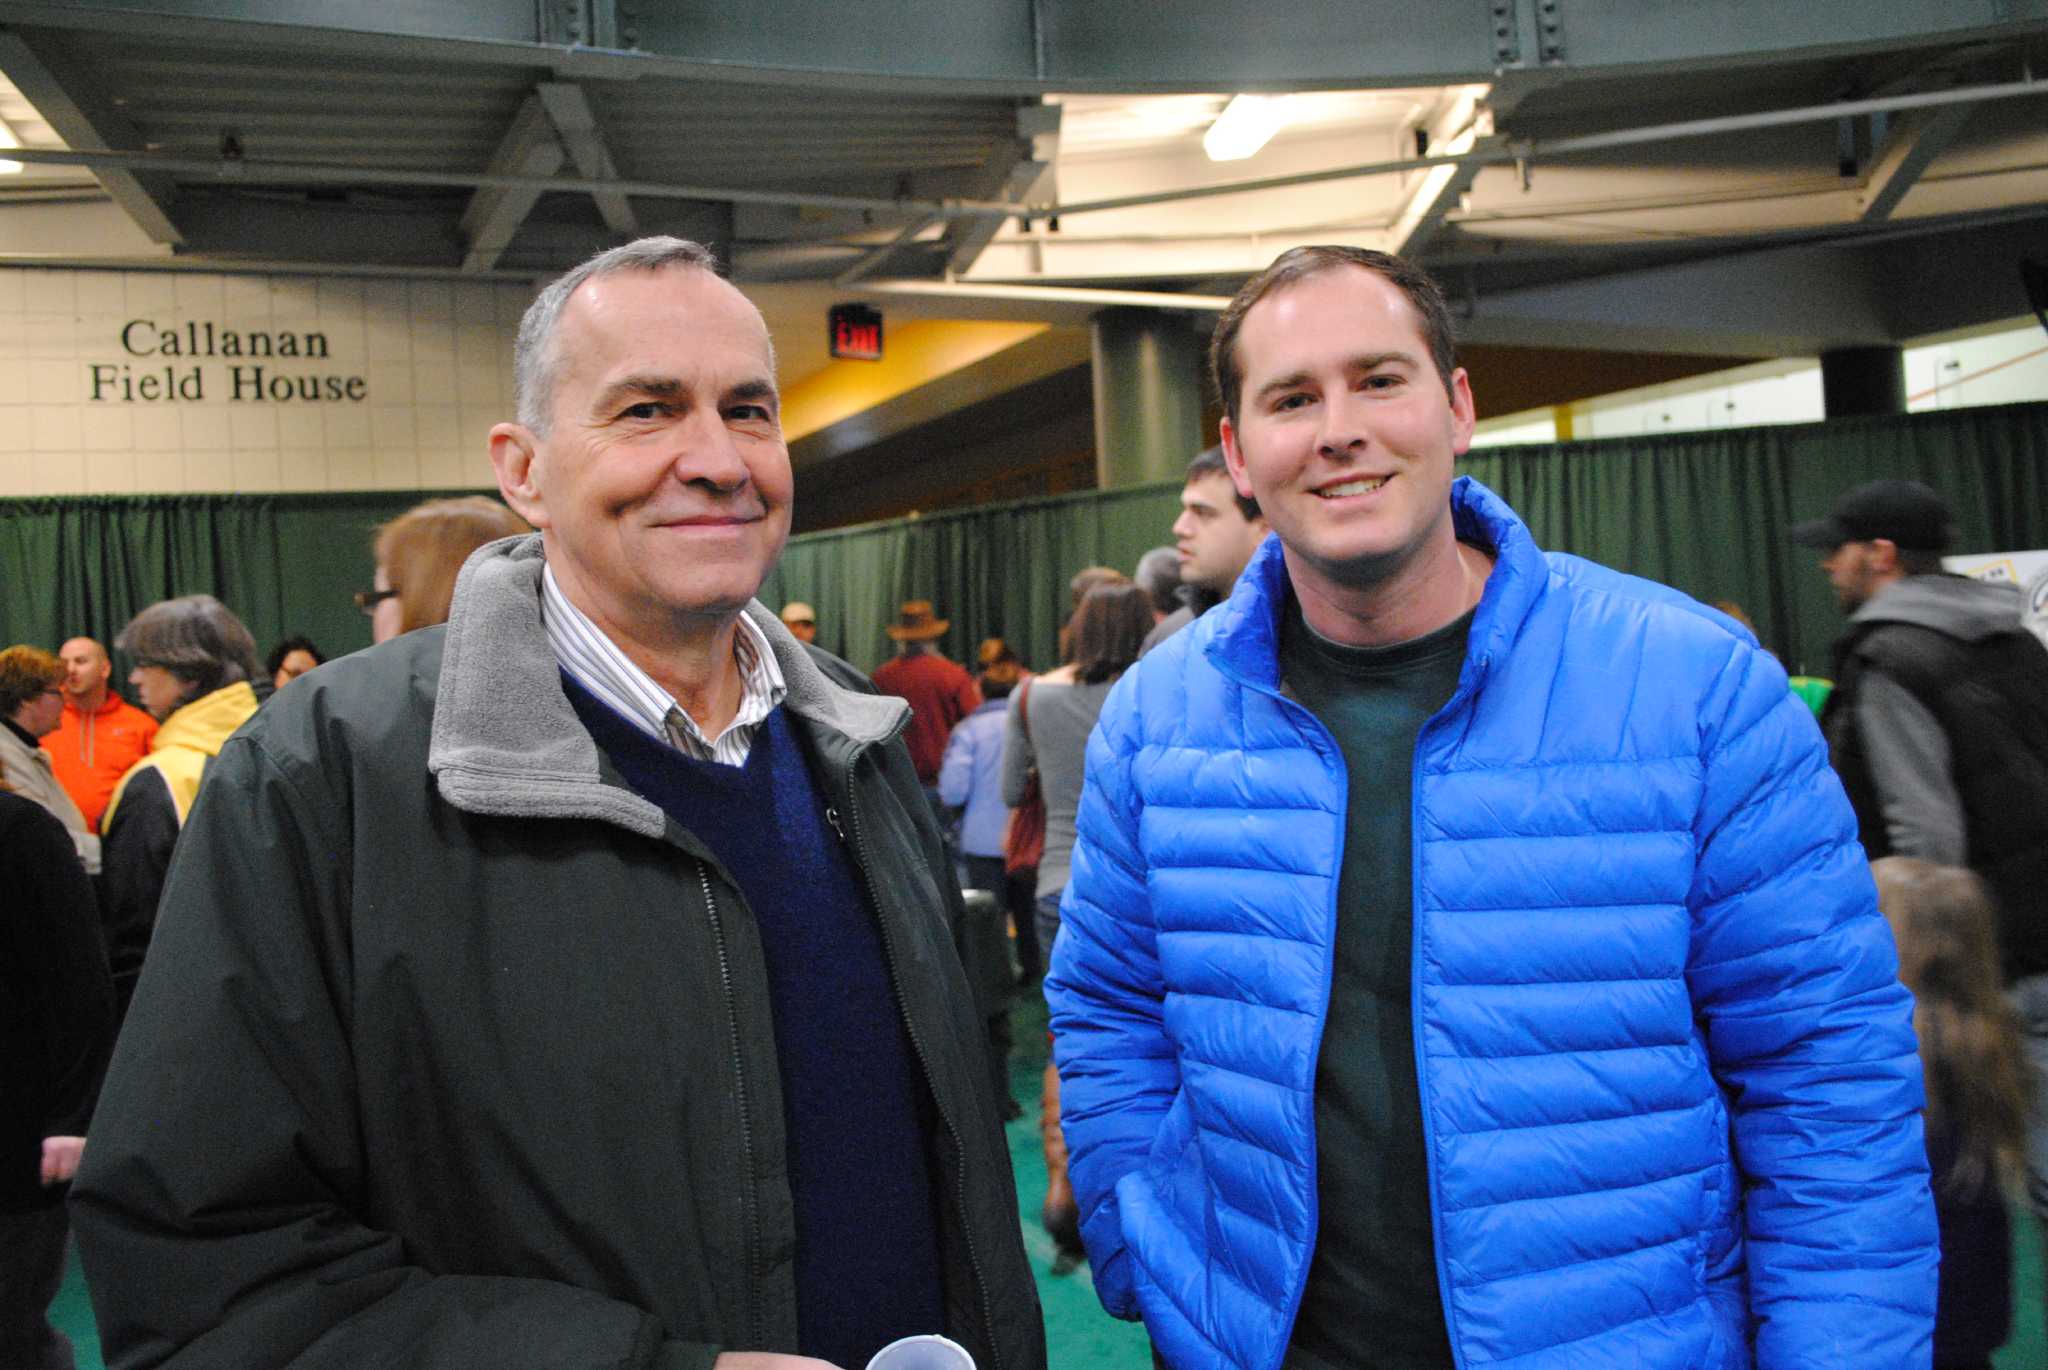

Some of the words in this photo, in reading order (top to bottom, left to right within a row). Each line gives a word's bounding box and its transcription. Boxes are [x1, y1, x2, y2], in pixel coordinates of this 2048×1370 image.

[121, 319, 330, 358] Callanan
[836, 322, 879, 354] EXIT
[90, 364, 204, 402] Field
[229, 364, 367, 402] House
